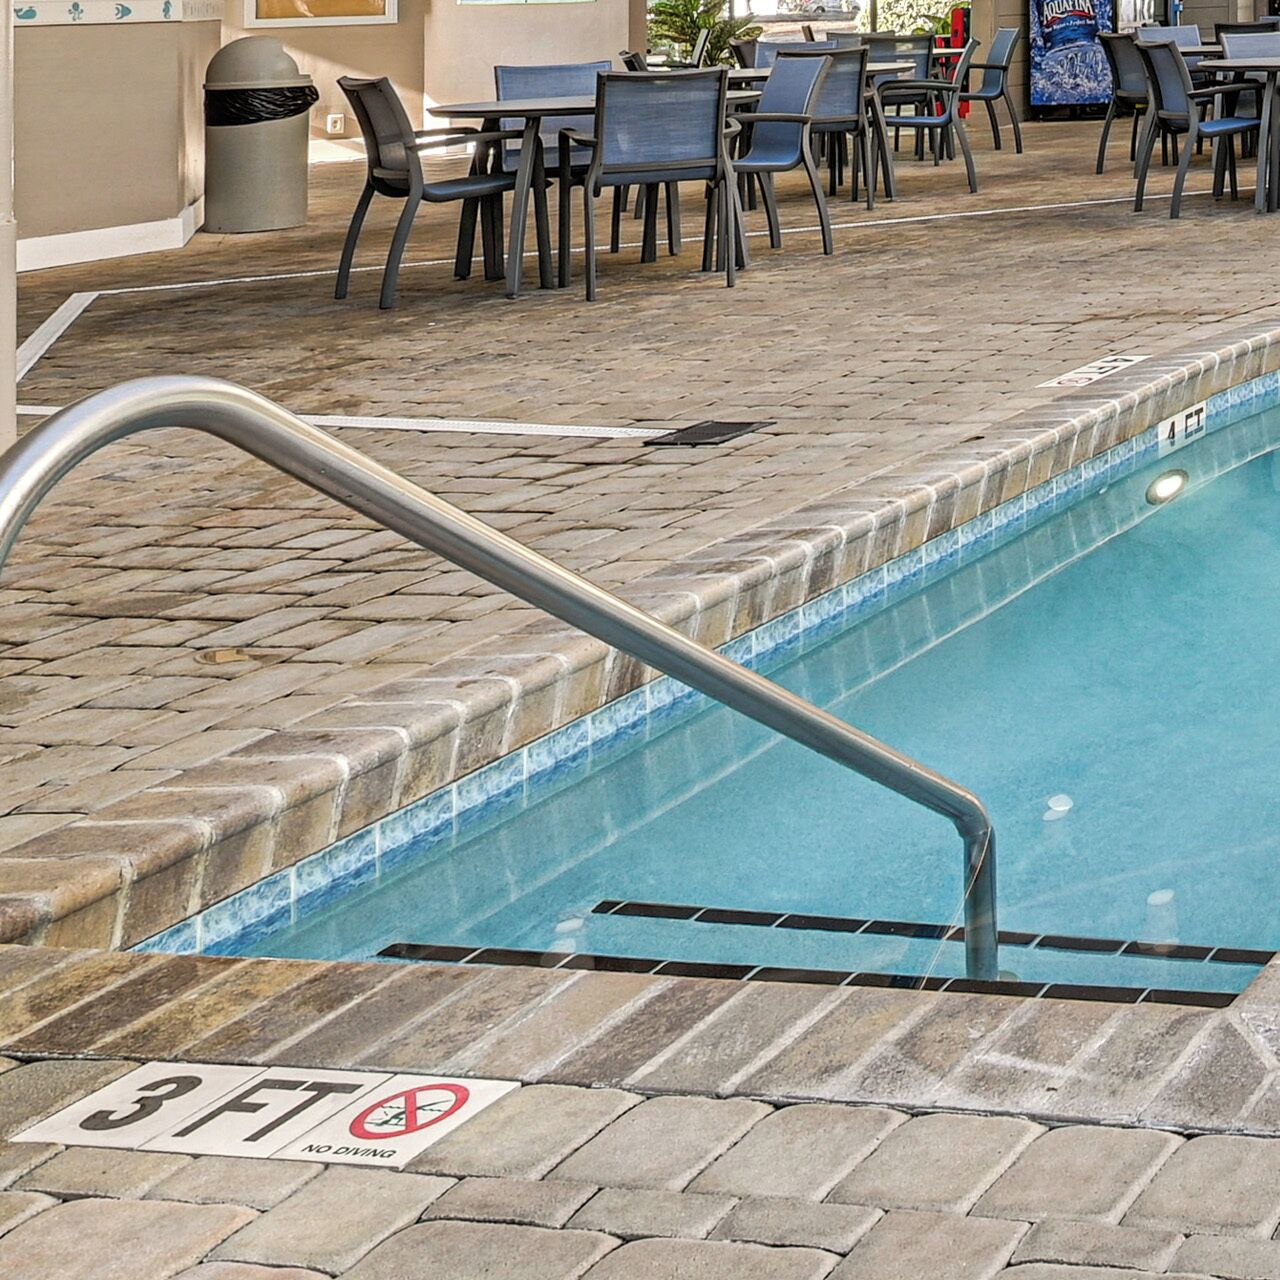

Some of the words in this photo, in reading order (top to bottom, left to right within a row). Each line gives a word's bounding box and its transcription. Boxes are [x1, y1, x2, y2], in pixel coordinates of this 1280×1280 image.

[1168, 420, 1175, 440] 4
[79, 1075, 204, 1130] 3
[172, 1078, 364, 1142] FT
[302, 1144, 333, 1154] NO
[335, 1146, 397, 1159] DIVING
